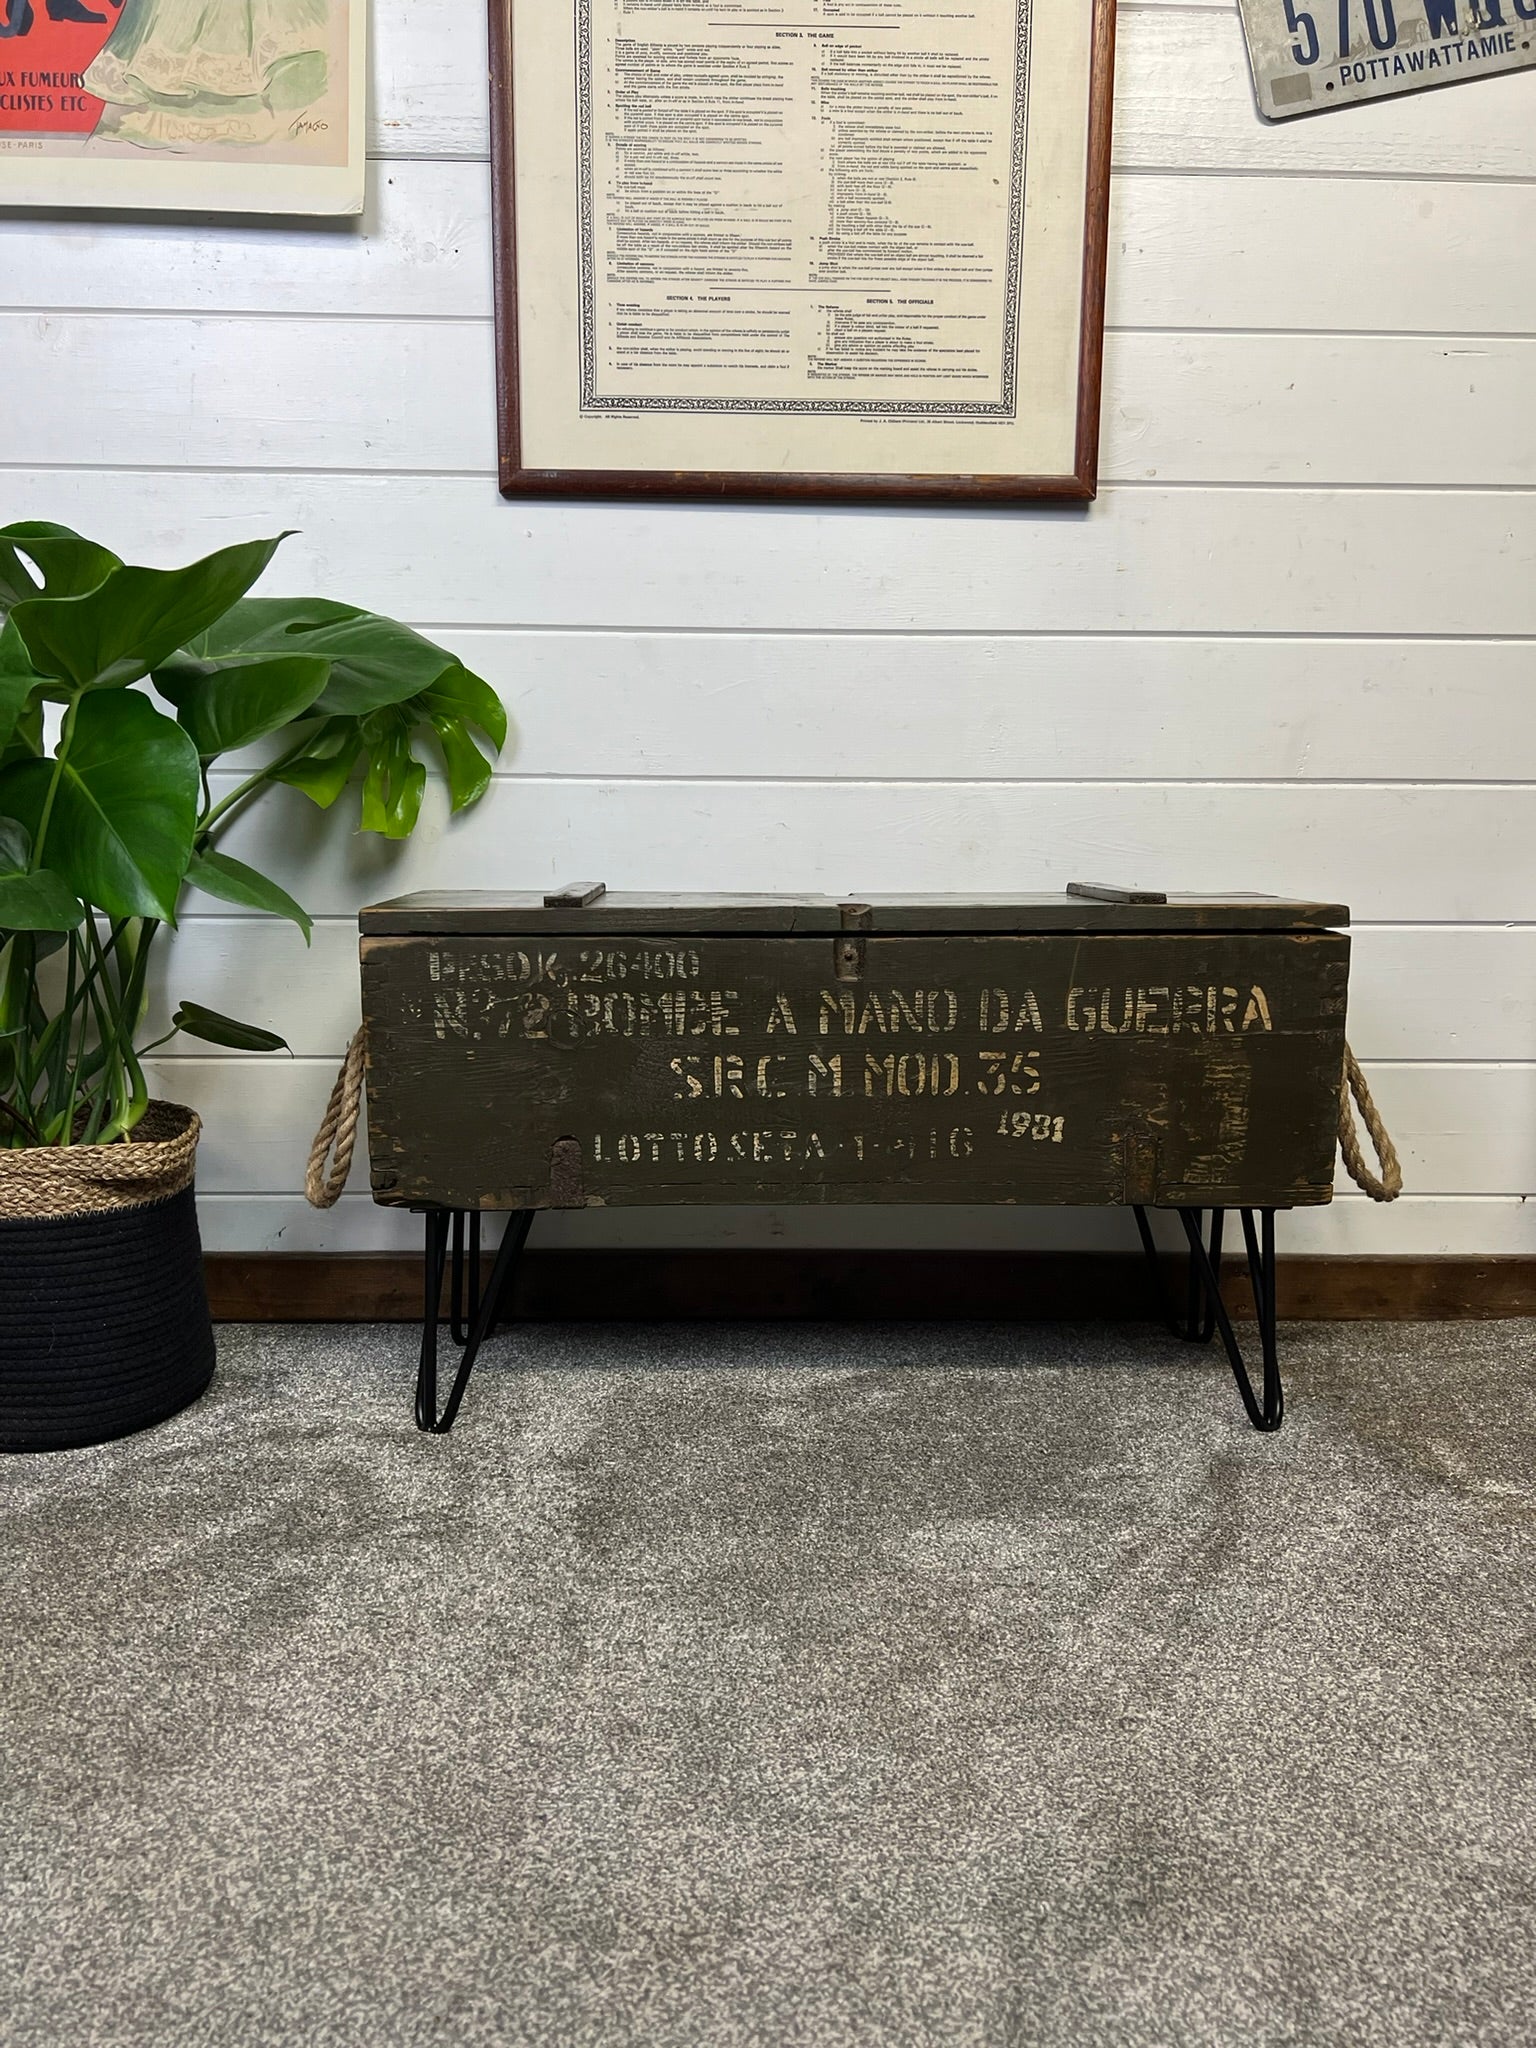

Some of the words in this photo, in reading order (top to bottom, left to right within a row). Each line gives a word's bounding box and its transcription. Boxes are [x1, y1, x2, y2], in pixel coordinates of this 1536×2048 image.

[1339, 31, 1517, 86] POTTAWATTAMIE
[60, 95, 88, 112] ETC
[0, 141, 44, 150] SE-PARIS
[766, 991, 798, 1035] A
[818, 989, 959, 1035] MANO
[979, 988, 1044, 1034] DA
[1065, 984, 1273, 1034] GUERRA
